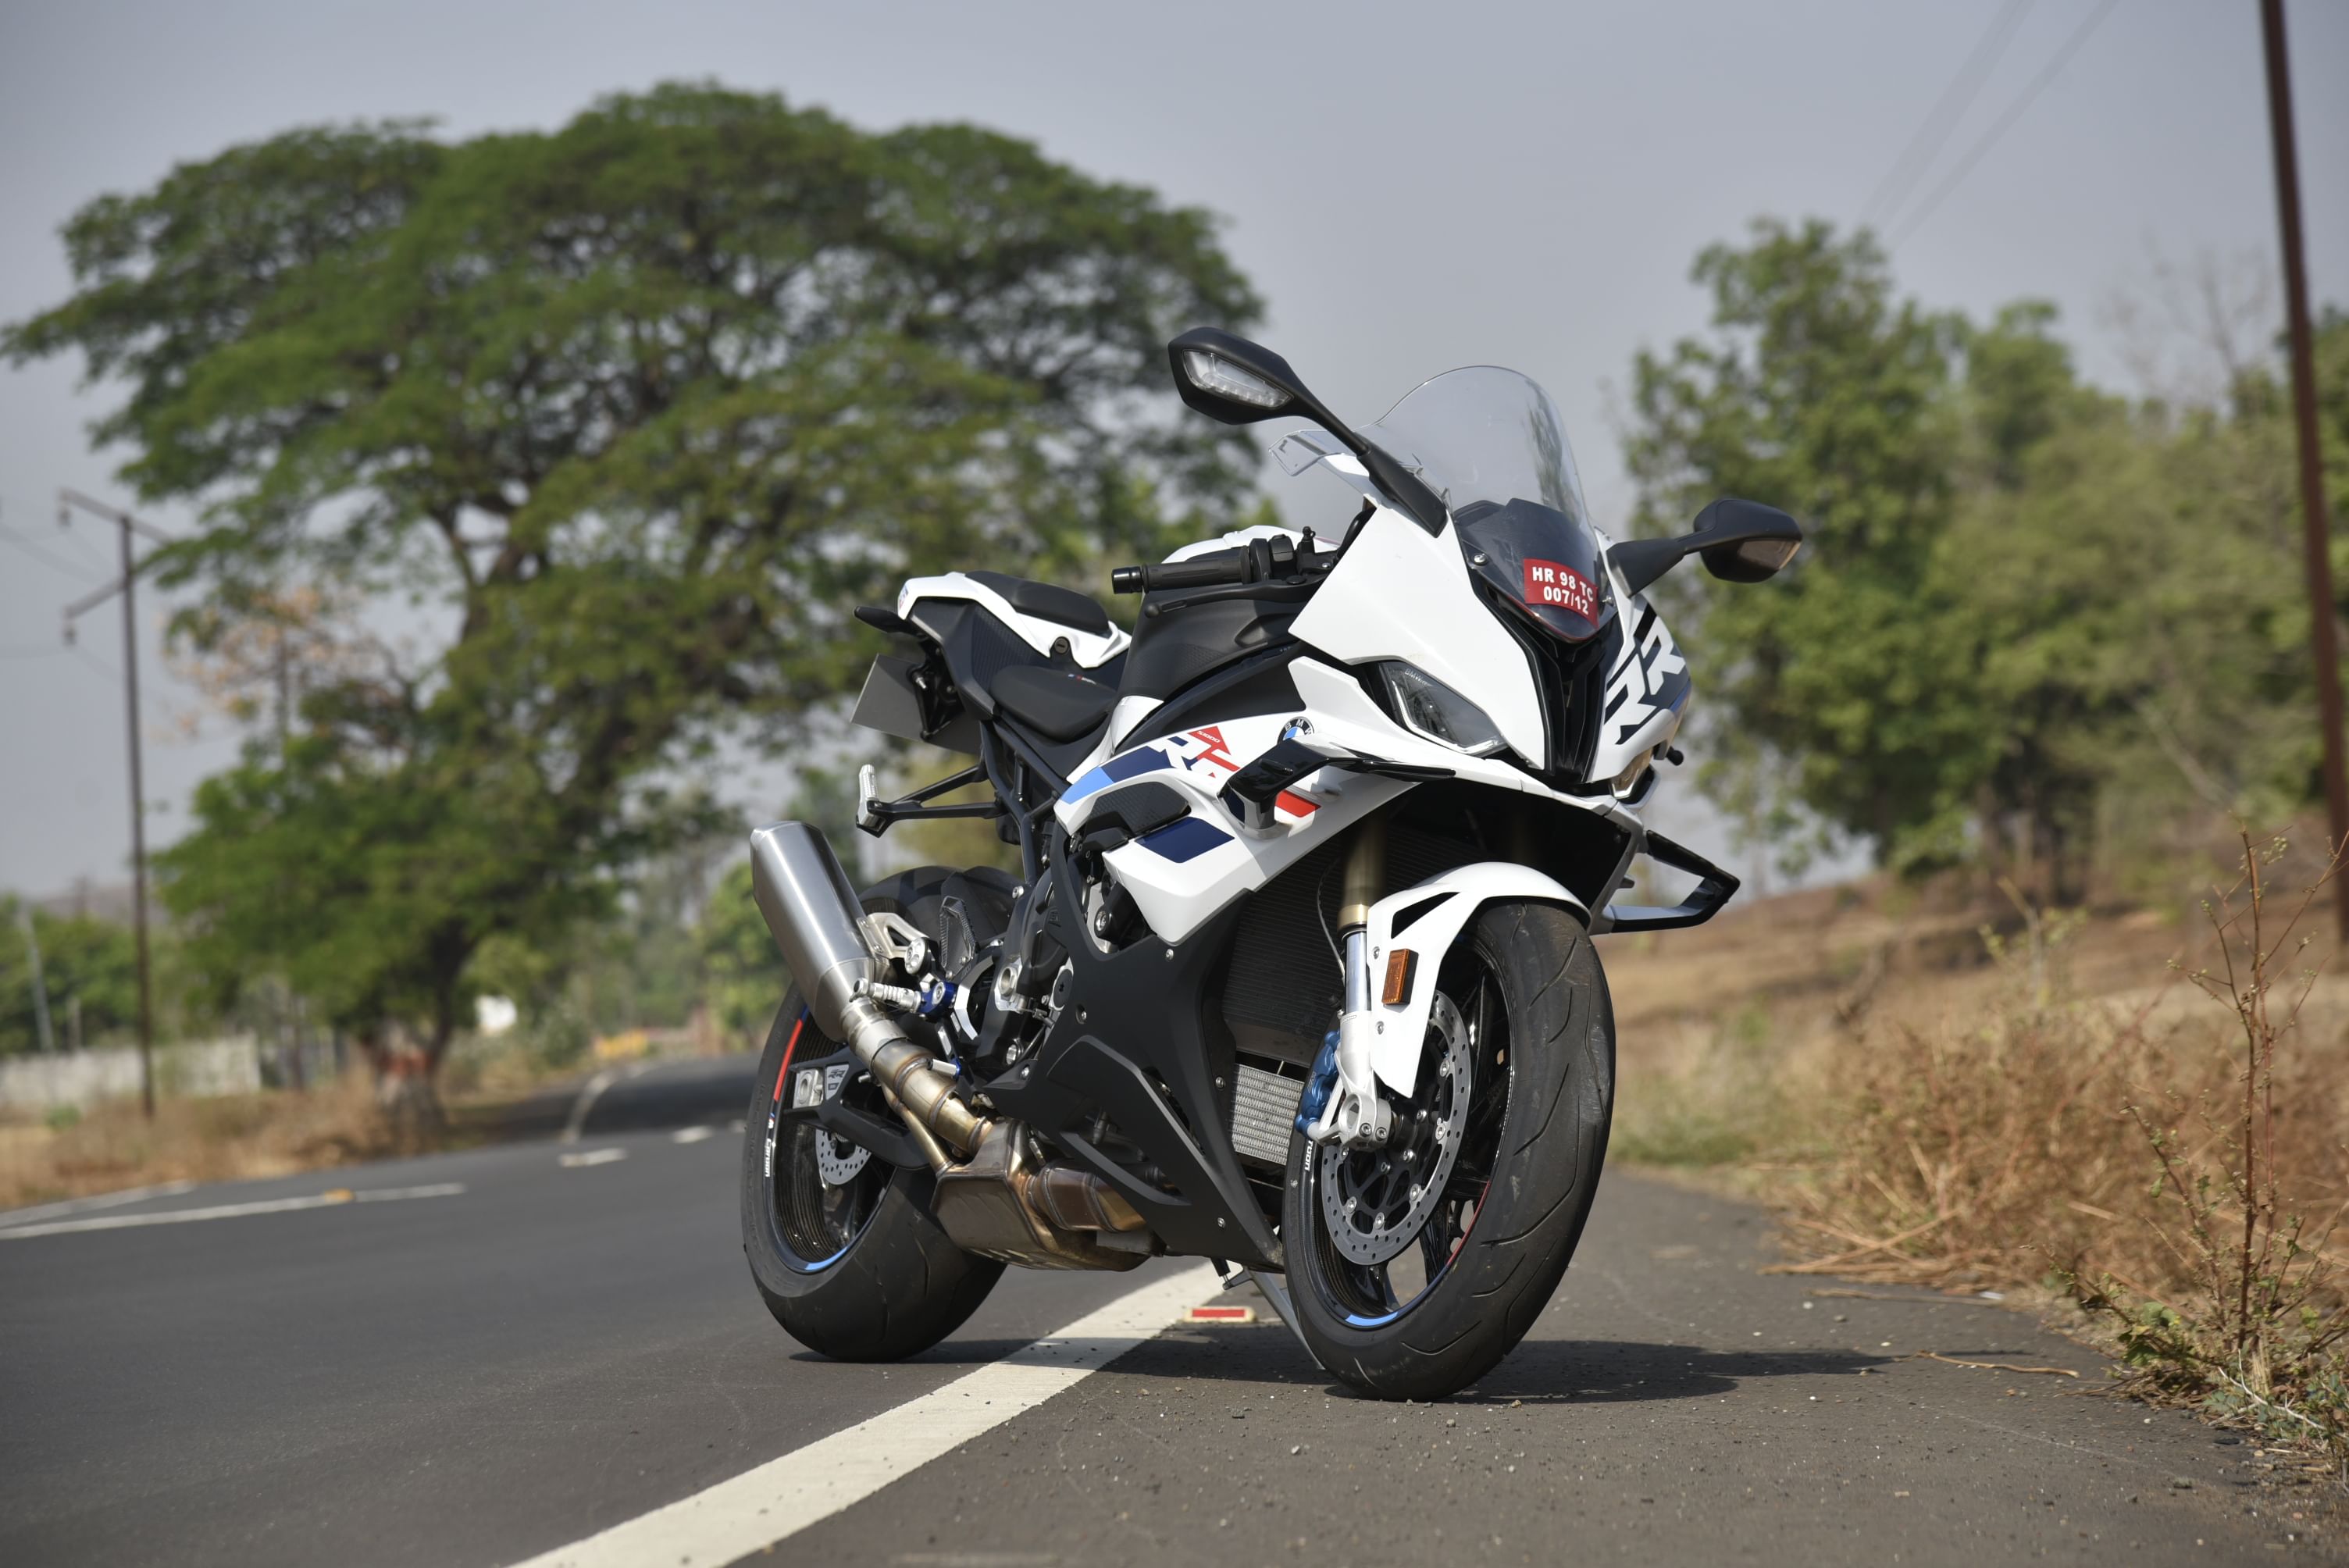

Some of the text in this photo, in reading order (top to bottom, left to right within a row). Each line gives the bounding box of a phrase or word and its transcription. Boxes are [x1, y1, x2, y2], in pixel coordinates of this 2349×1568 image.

[1532, 566, 1594, 602] HR 98 TC
[1543, 586, 1588, 615] 007/12
[1196, 730, 1221, 743] S1000
